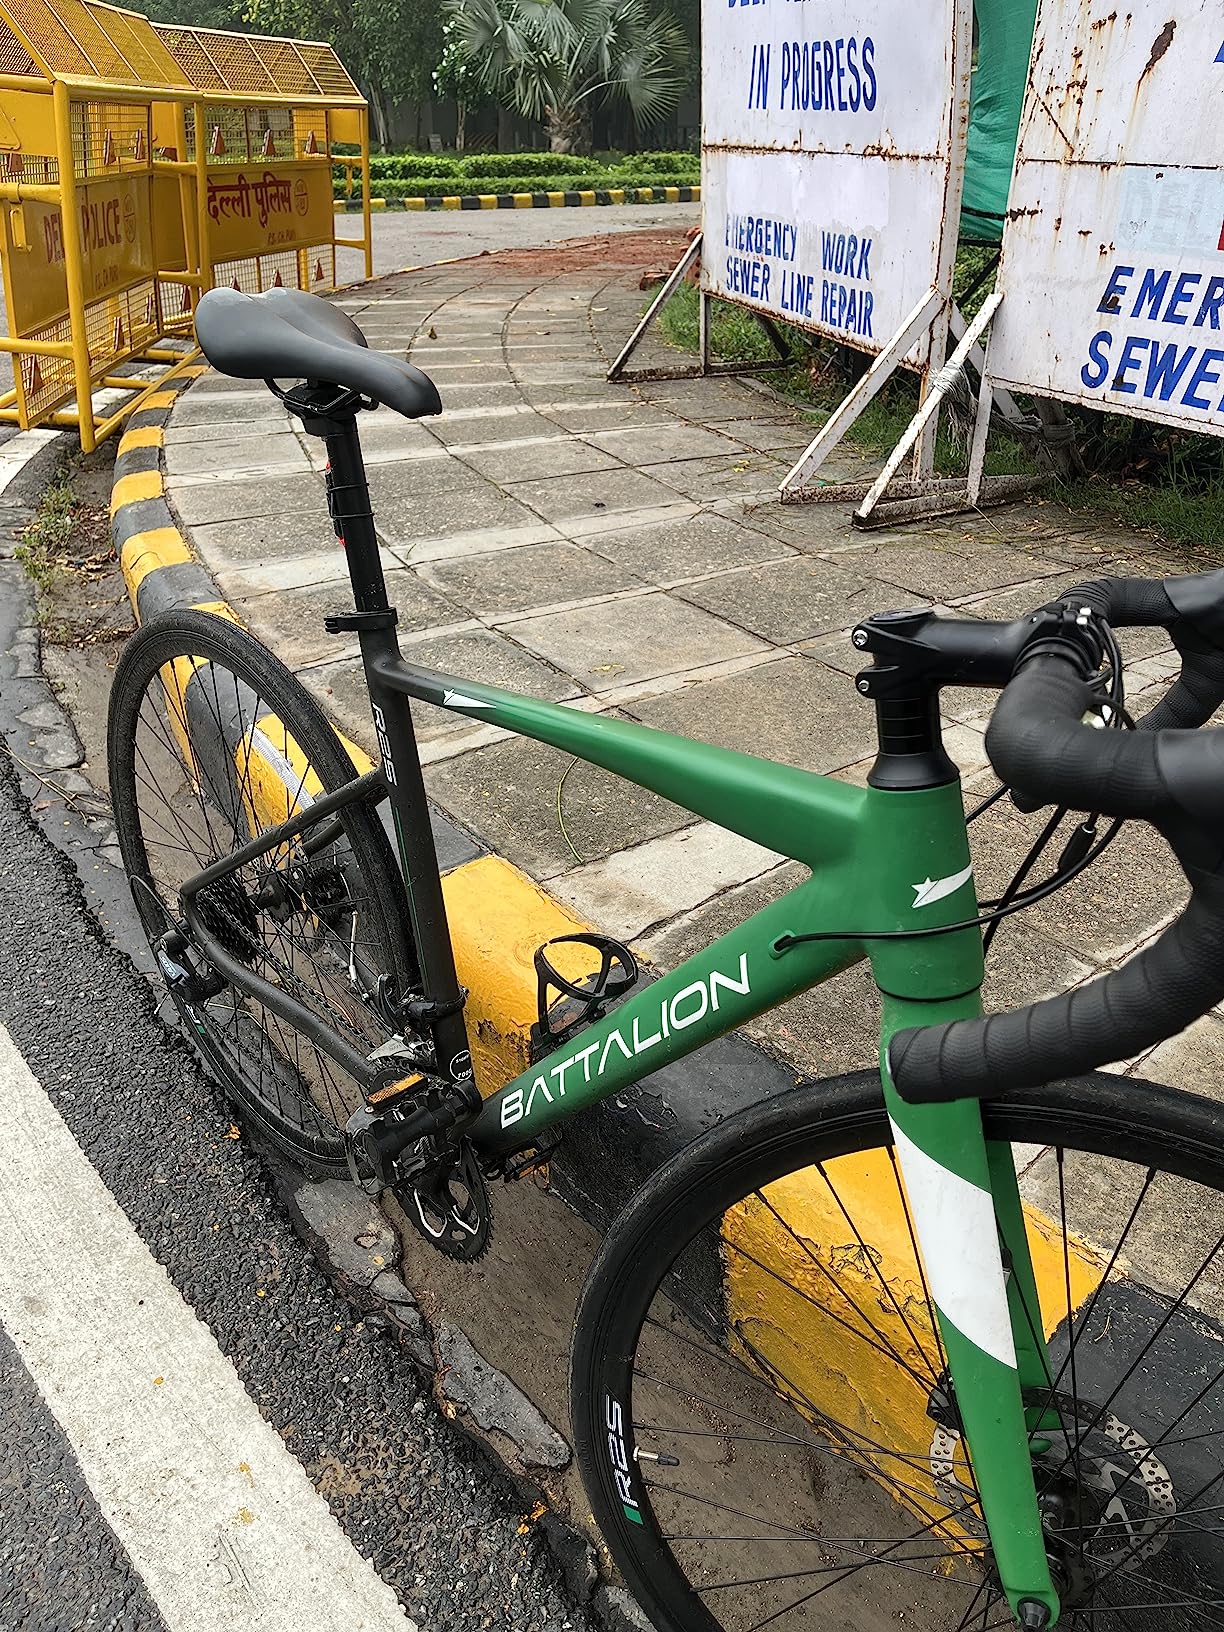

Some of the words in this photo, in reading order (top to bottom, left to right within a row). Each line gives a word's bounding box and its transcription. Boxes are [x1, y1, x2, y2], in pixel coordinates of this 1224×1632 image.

[748, 44, 771, 110] IN
[781, 37, 877, 112] PROGRESS
[251, 171, 291, 228] पुलिस
[822, 231, 873, 281] WORK
[726, 255, 770, 302] SEWER
[781, 270, 814, 318] LINE
[821, 280, 874, 338] REPAIR
[1080, 331, 1224, 412] SEWE
[500, 952, 752, 1129] BATTALION
